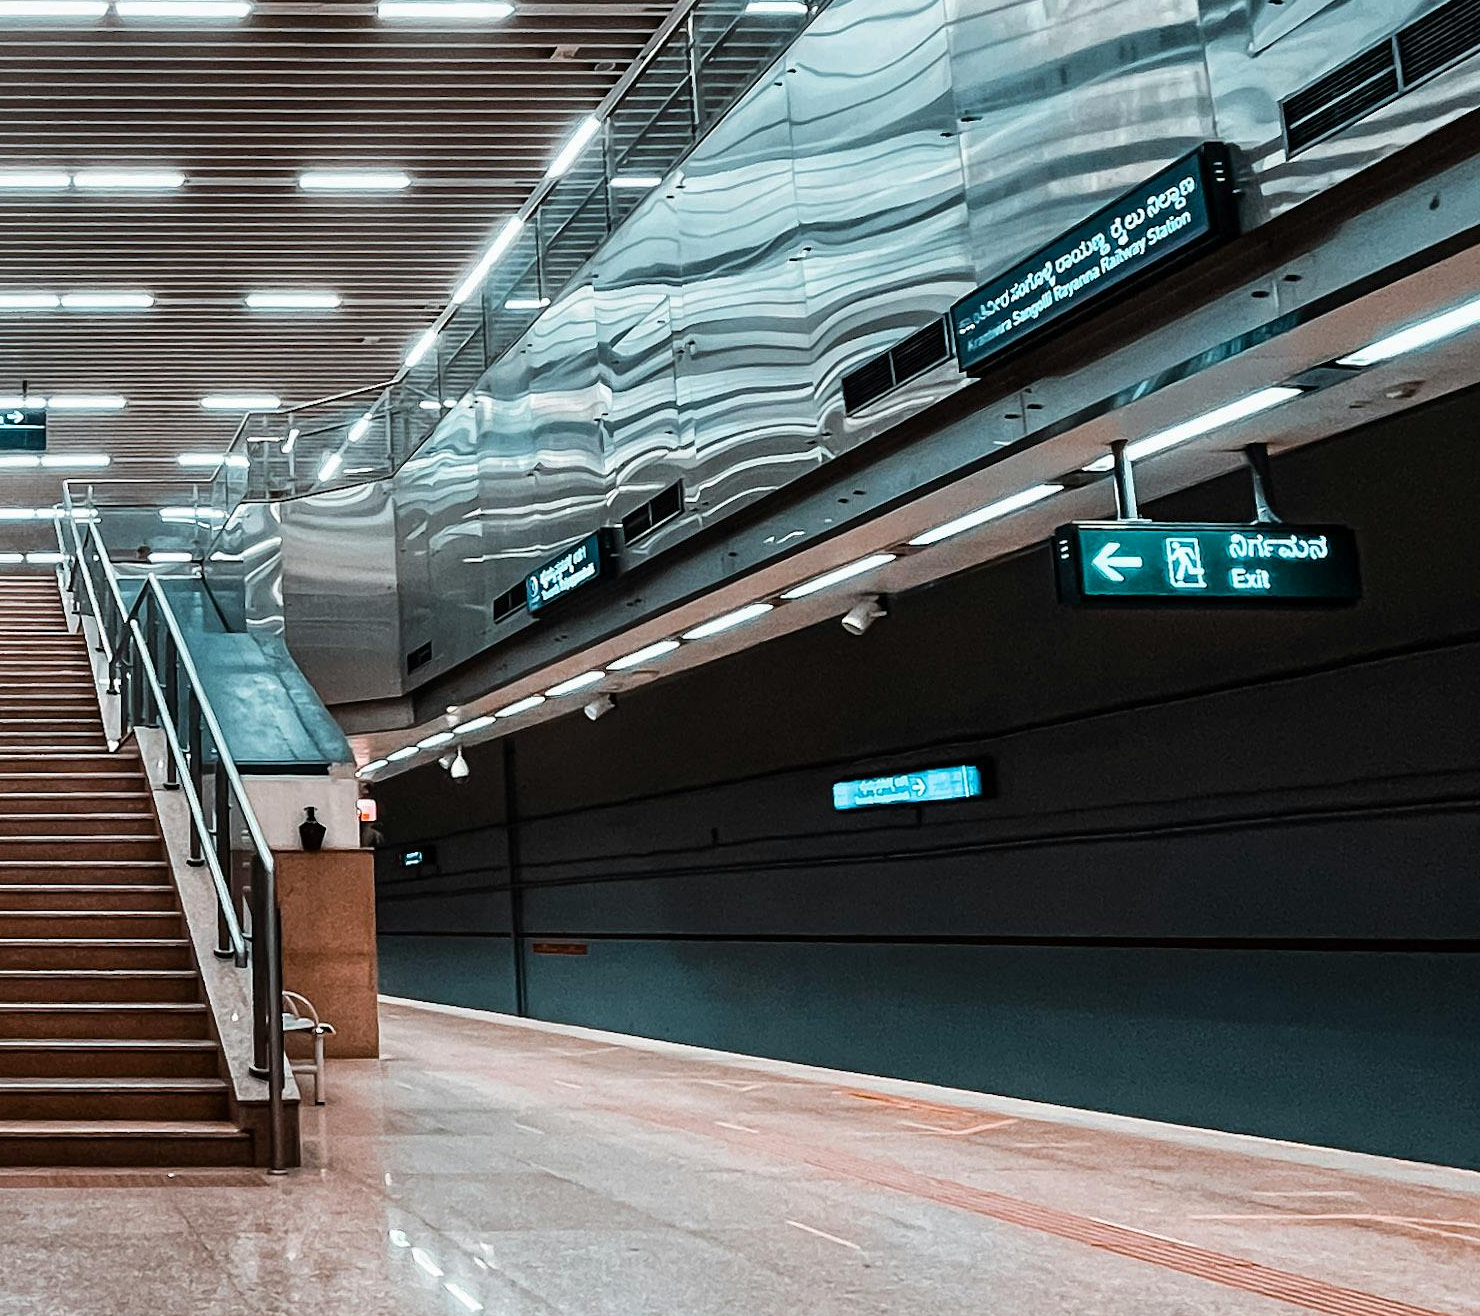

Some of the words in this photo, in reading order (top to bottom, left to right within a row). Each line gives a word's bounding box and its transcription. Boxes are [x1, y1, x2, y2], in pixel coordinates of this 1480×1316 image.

[1012, 289, 1053, 326] Sangolli
[1053, 266, 1100, 301] Rayanna
[1100, 237, 1146, 274] Railway
[1146, 211, 1192, 245] Station
[1228, 533, 1329, 559] ನಿರ್ಗಮನ
[1230, 567, 1271, 589] Exit
